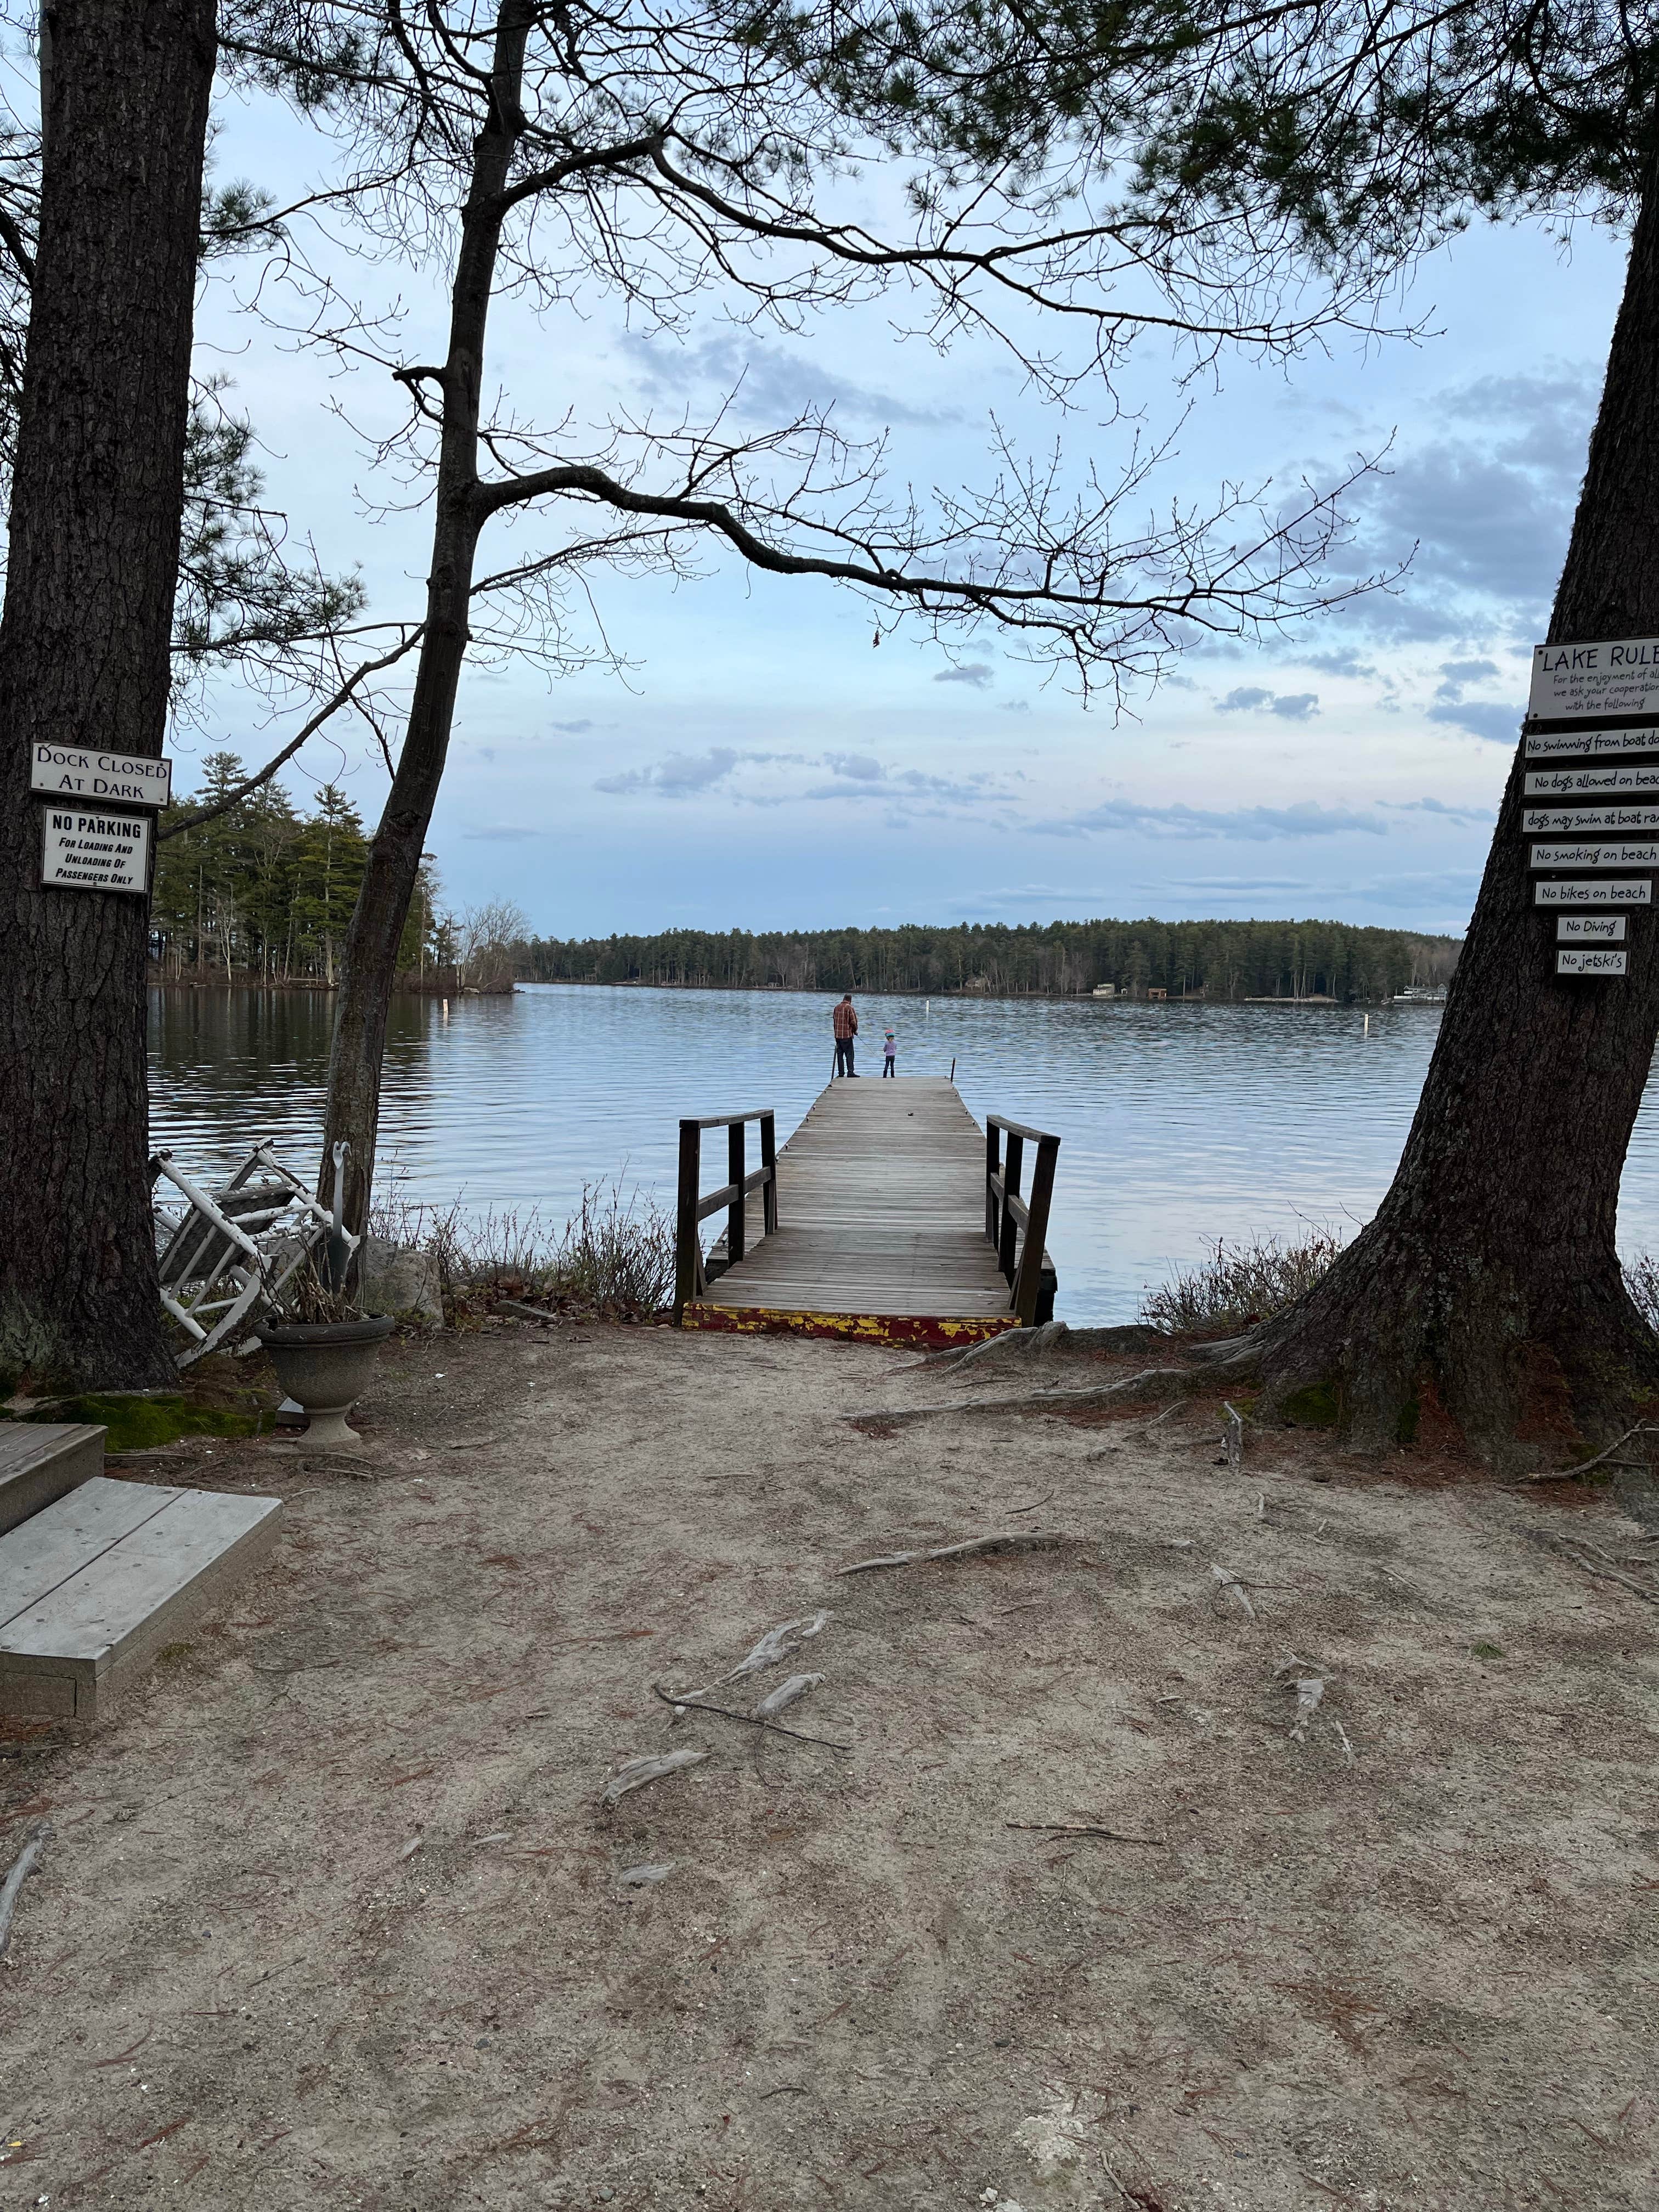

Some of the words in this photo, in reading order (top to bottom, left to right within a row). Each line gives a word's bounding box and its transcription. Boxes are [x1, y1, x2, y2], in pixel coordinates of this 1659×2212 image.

[1542, 648, 1598, 672] LAKE
[1554, 675, 1567, 684] For
[1570, 674, 1584, 683] the
[1587, 672, 1635, 686] enjoyment
[1637, 668, 1648, 679] of
[1570, 686, 1583, 695] ask
[1583, 687, 1606, 698] your
[1566, 700, 1584, 710] with
[1587, 701, 1601, 710] the
[1604, 697, 1645, 710] following
[1528, 741, 1541, 752] No
[1543, 736, 1593, 753] swimming
[1594, 734, 1620, 750] from
[1623, 733, 1646, 747] boat
[37, 747, 89, 768] DOCK
[98, 757, 167, 778] CLOSED
[58, 775, 84, 790] AT
[94, 779, 144, 799] DARK
[1535, 777, 1548, 788] No
[1551, 774, 1573, 791] dogs
[1576, 771, 1616, 788] allowed
[1621, 777, 1632, 786] on
[53, 815, 72, 831] NO
[78, 817, 141, 838] PARKING
[1528, 811, 1549, 830] dogs
[1552, 816, 1573, 830] may
[1575, 814, 1601, 826] swim
[1604, 812, 1615, 824] at
[1618, 810, 1641, 825] boat
[58, 837, 75, 848] FOR
[78, 839, 113, 852] LOADING
[115, 844, 133, 855] AND
[65, 854, 111, 867] UNLOADING
[114, 859, 126, 868] OF
[1537, 849, 1551, 860] No
[1553, 847, 1601, 864] smoking
[1603, 851, 1617, 860] on
[1621, 847, 1656, 860] beach
[56, 868, 108, 882] PASSENGERS
[111, 873, 133, 884] ONLY
[1542, 888, 1556, 898] No
[1560, 886, 1589, 900] bikes
[1593, 890, 1606, 898] on
[1611, 885, 1645, 899] beach
[1566, 921, 1580, 931] No
[1584, 921, 1616, 936] Diving
[1562, 954, 1576, 965] No
[1578, 953, 1622, 971] jetski's
